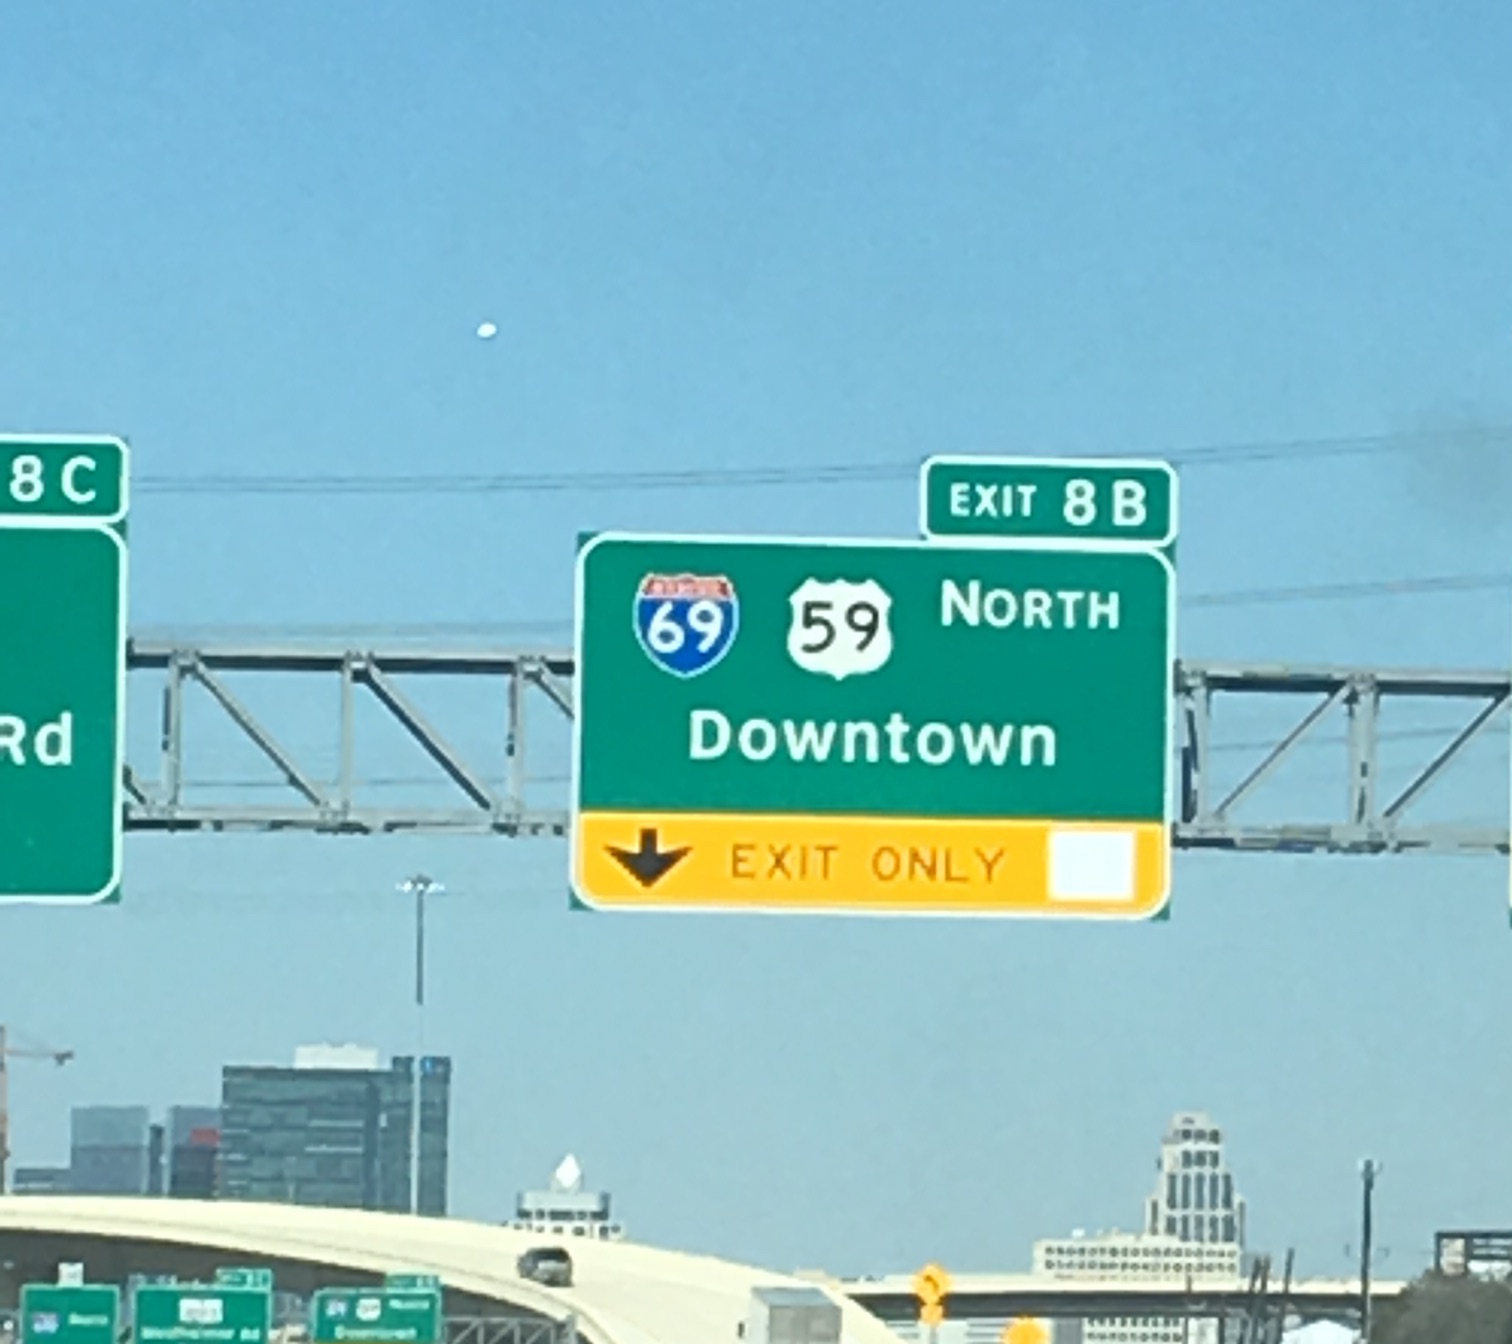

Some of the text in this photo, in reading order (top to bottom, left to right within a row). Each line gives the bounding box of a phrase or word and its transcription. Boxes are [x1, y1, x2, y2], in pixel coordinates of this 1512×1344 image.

[8, 454, 97, 505] 8 C
[949, 477, 1148, 527] EXIT 8 B
[646, 600, 724, 654] 69
[800, 599, 880, 654] 59
[940, 578, 1120, 630] NORTH
[0, 710, 73, 767] Rd
[689, 708, 1057, 767] Downtown
[730, 842, 1006, 884] EXIT ONLY
